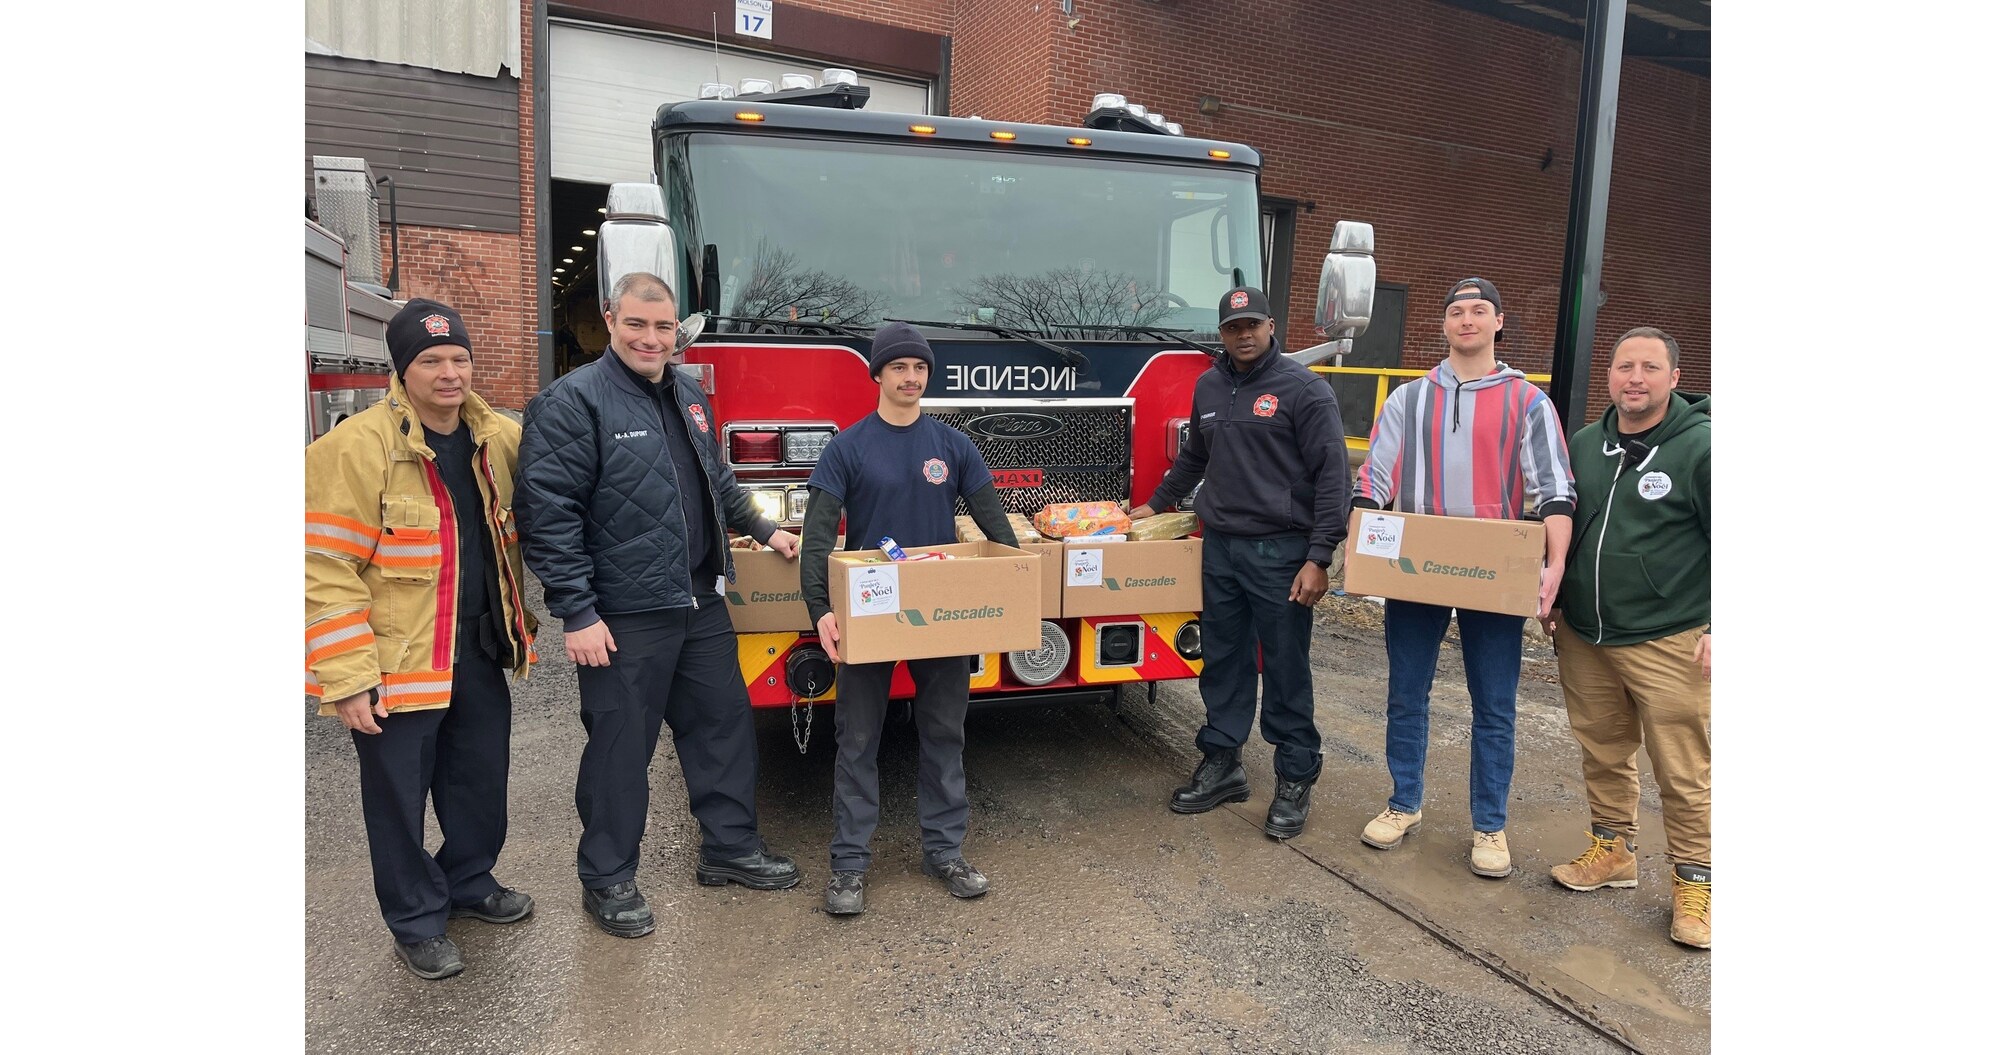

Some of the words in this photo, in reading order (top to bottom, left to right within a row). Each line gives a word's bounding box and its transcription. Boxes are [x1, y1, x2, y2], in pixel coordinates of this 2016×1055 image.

[743, 14, 765, 32] 17
[989, 415, 1042, 434] Pierce
[993, 473, 1039, 484] MAXI
[1377, 533, 1396, 542] Noël
[1513, 528, 1528, 539] 34
[1013, 563, 1029, 571] 34
[1422, 560, 1496, 580] Cascades
[1124, 576, 1177, 588] Cascades
[871, 586, 892, 597] Noël
[932, 605, 1004, 621] Cascades
